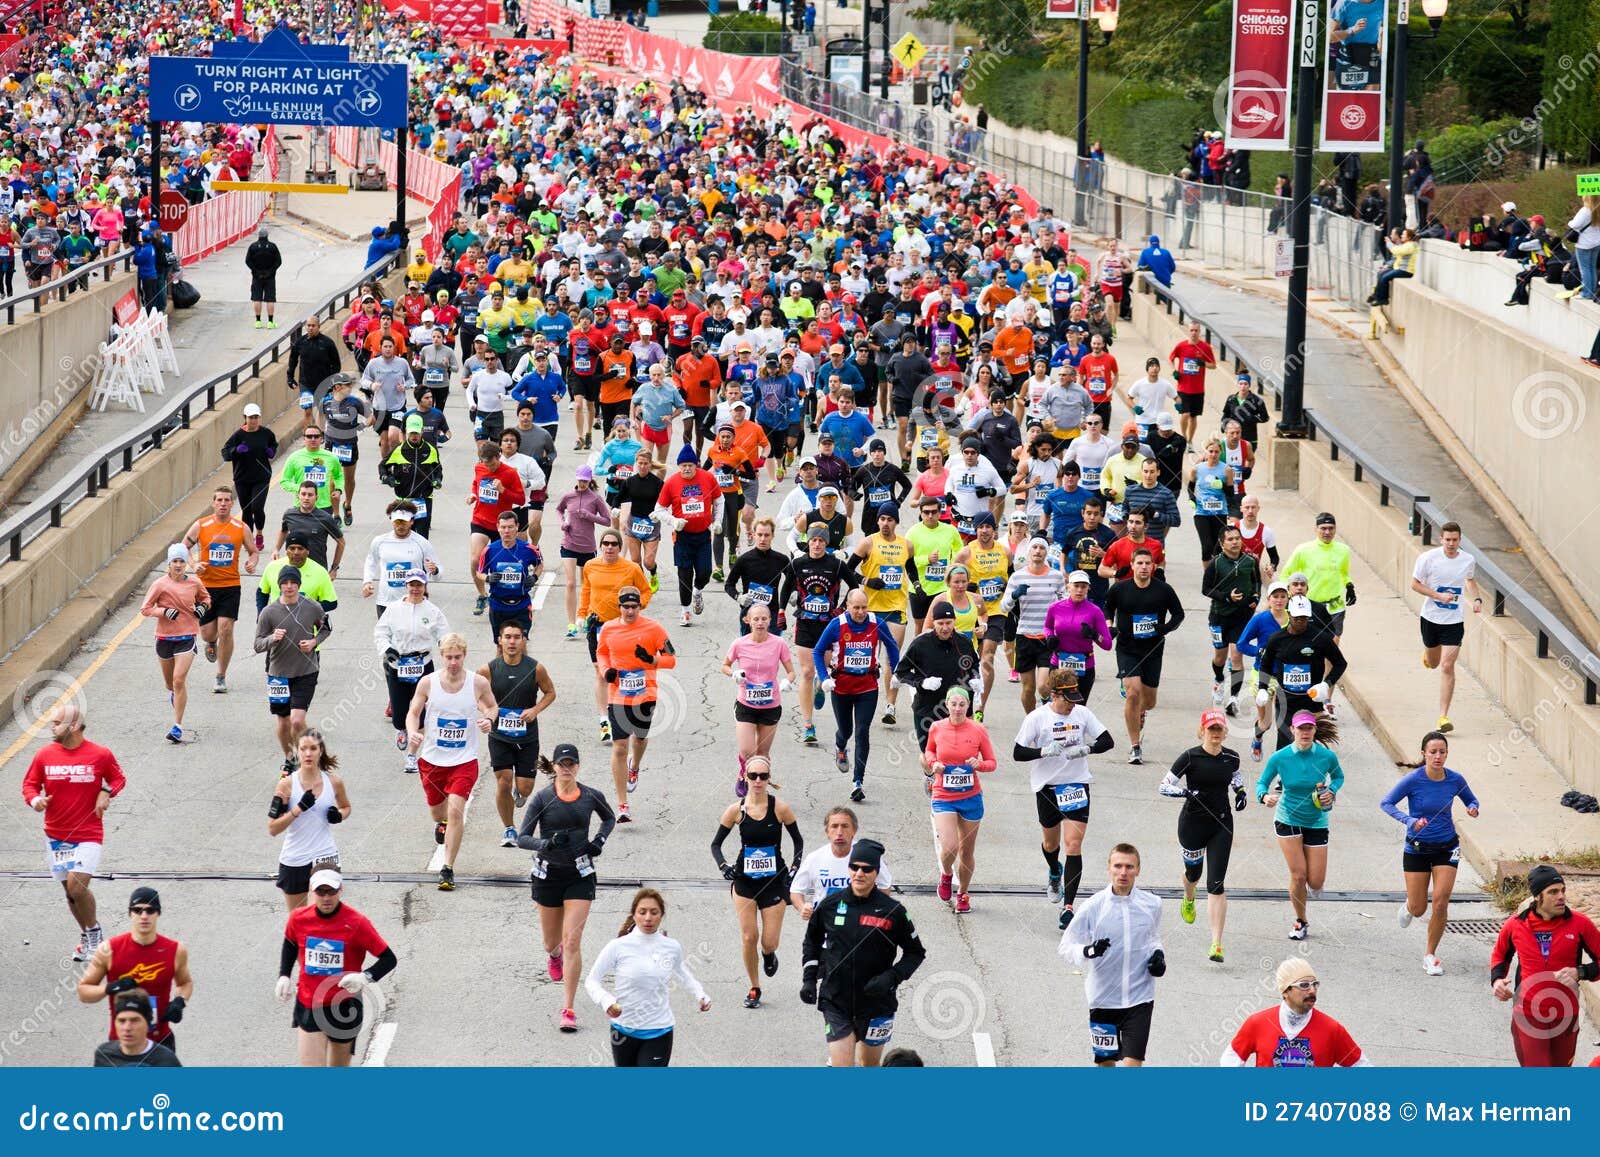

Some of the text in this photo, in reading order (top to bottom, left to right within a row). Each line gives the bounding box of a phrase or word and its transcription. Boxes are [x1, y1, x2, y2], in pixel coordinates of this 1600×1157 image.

[1239, 14, 1287, 25] CHICAGO
[1242, 25, 1284, 35] STRIVES
[196, 64, 362, 80] TURN RIGHT AT LIGHT
[214, 80, 343, 95] FOR PARKING AT
[242, 101, 324, 112] MILLENNIUM
[271, 111, 324, 120] GARAGES
[160, 204, 187, 219] TOP
[1276, 1040, 1312, 1057] CHICAGO
